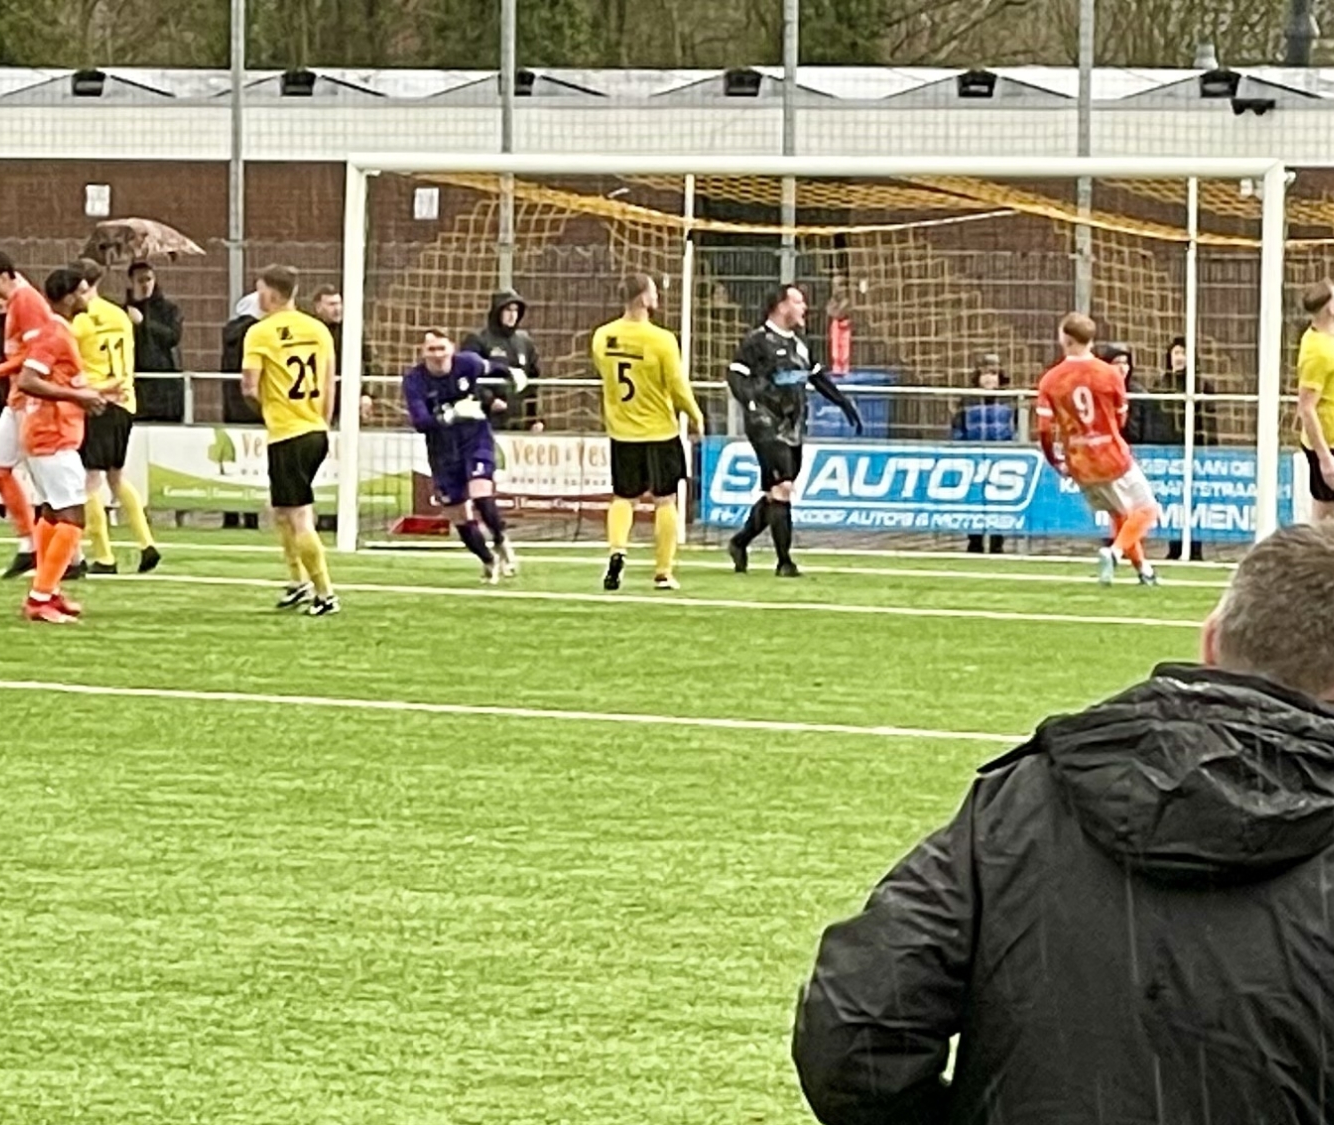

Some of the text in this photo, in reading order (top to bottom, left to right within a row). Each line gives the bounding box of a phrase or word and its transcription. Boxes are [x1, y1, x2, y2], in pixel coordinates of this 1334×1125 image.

[99, 337, 125, 377] 11
[286, 352, 321, 400] 21
[617, 361, 636, 402] 5
[1072, 385, 1096, 425] 9
[805, 454, 1029, 502] AUTO'S
